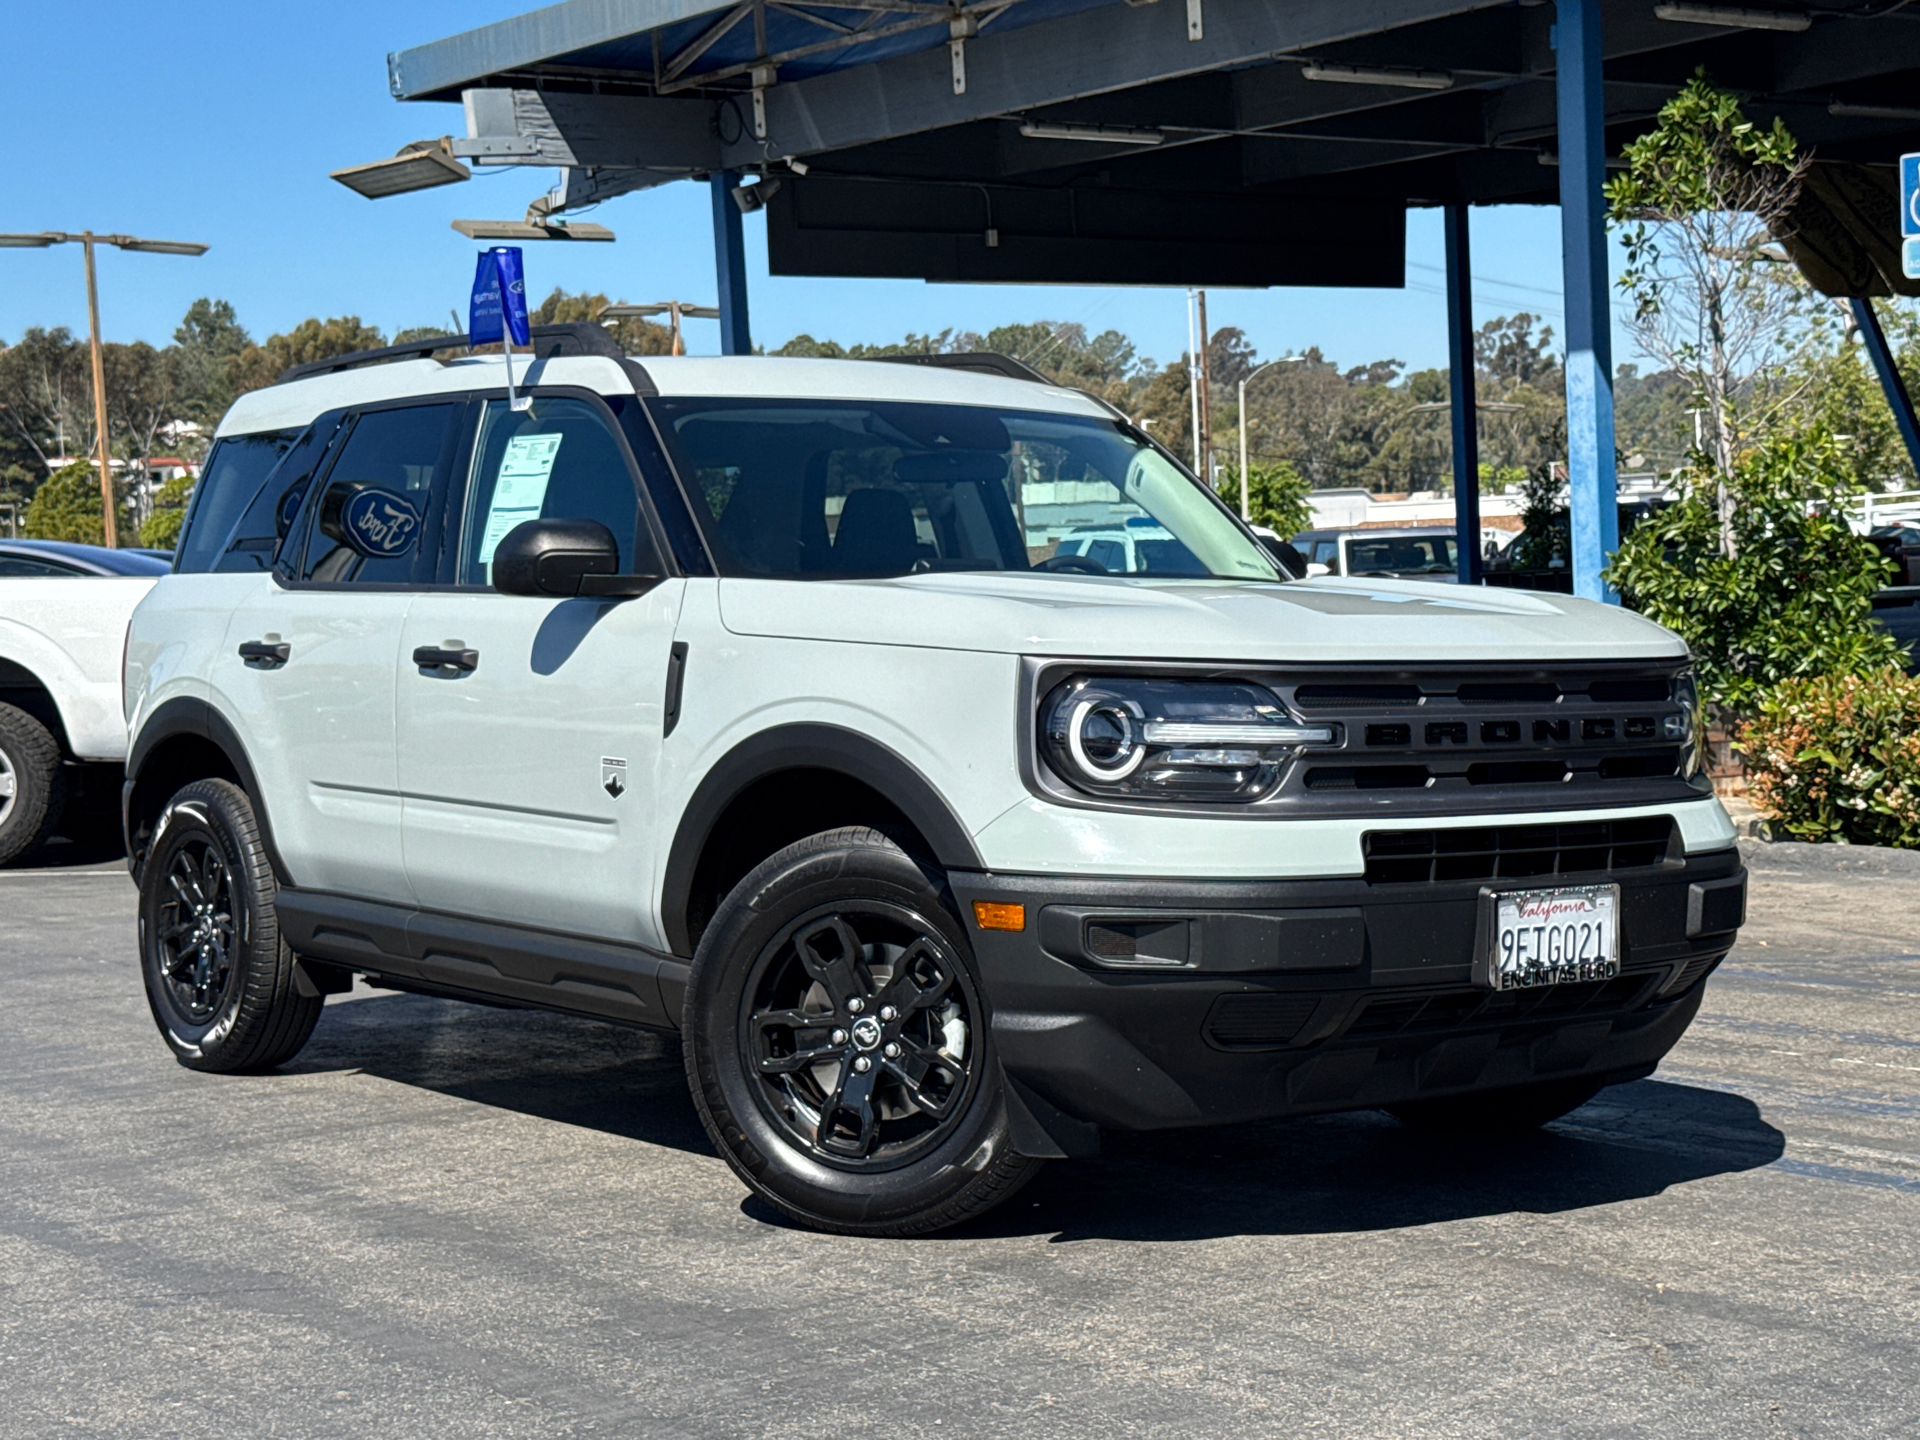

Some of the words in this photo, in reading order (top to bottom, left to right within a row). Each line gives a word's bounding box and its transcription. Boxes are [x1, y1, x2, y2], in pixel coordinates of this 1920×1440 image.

[1365, 717, 1656, 746] BRONCO
[1518, 895, 1593, 922] California
[1501, 966, 1577, 989] ENCINITAS
[1580, 961, 1615, 981] FORD
